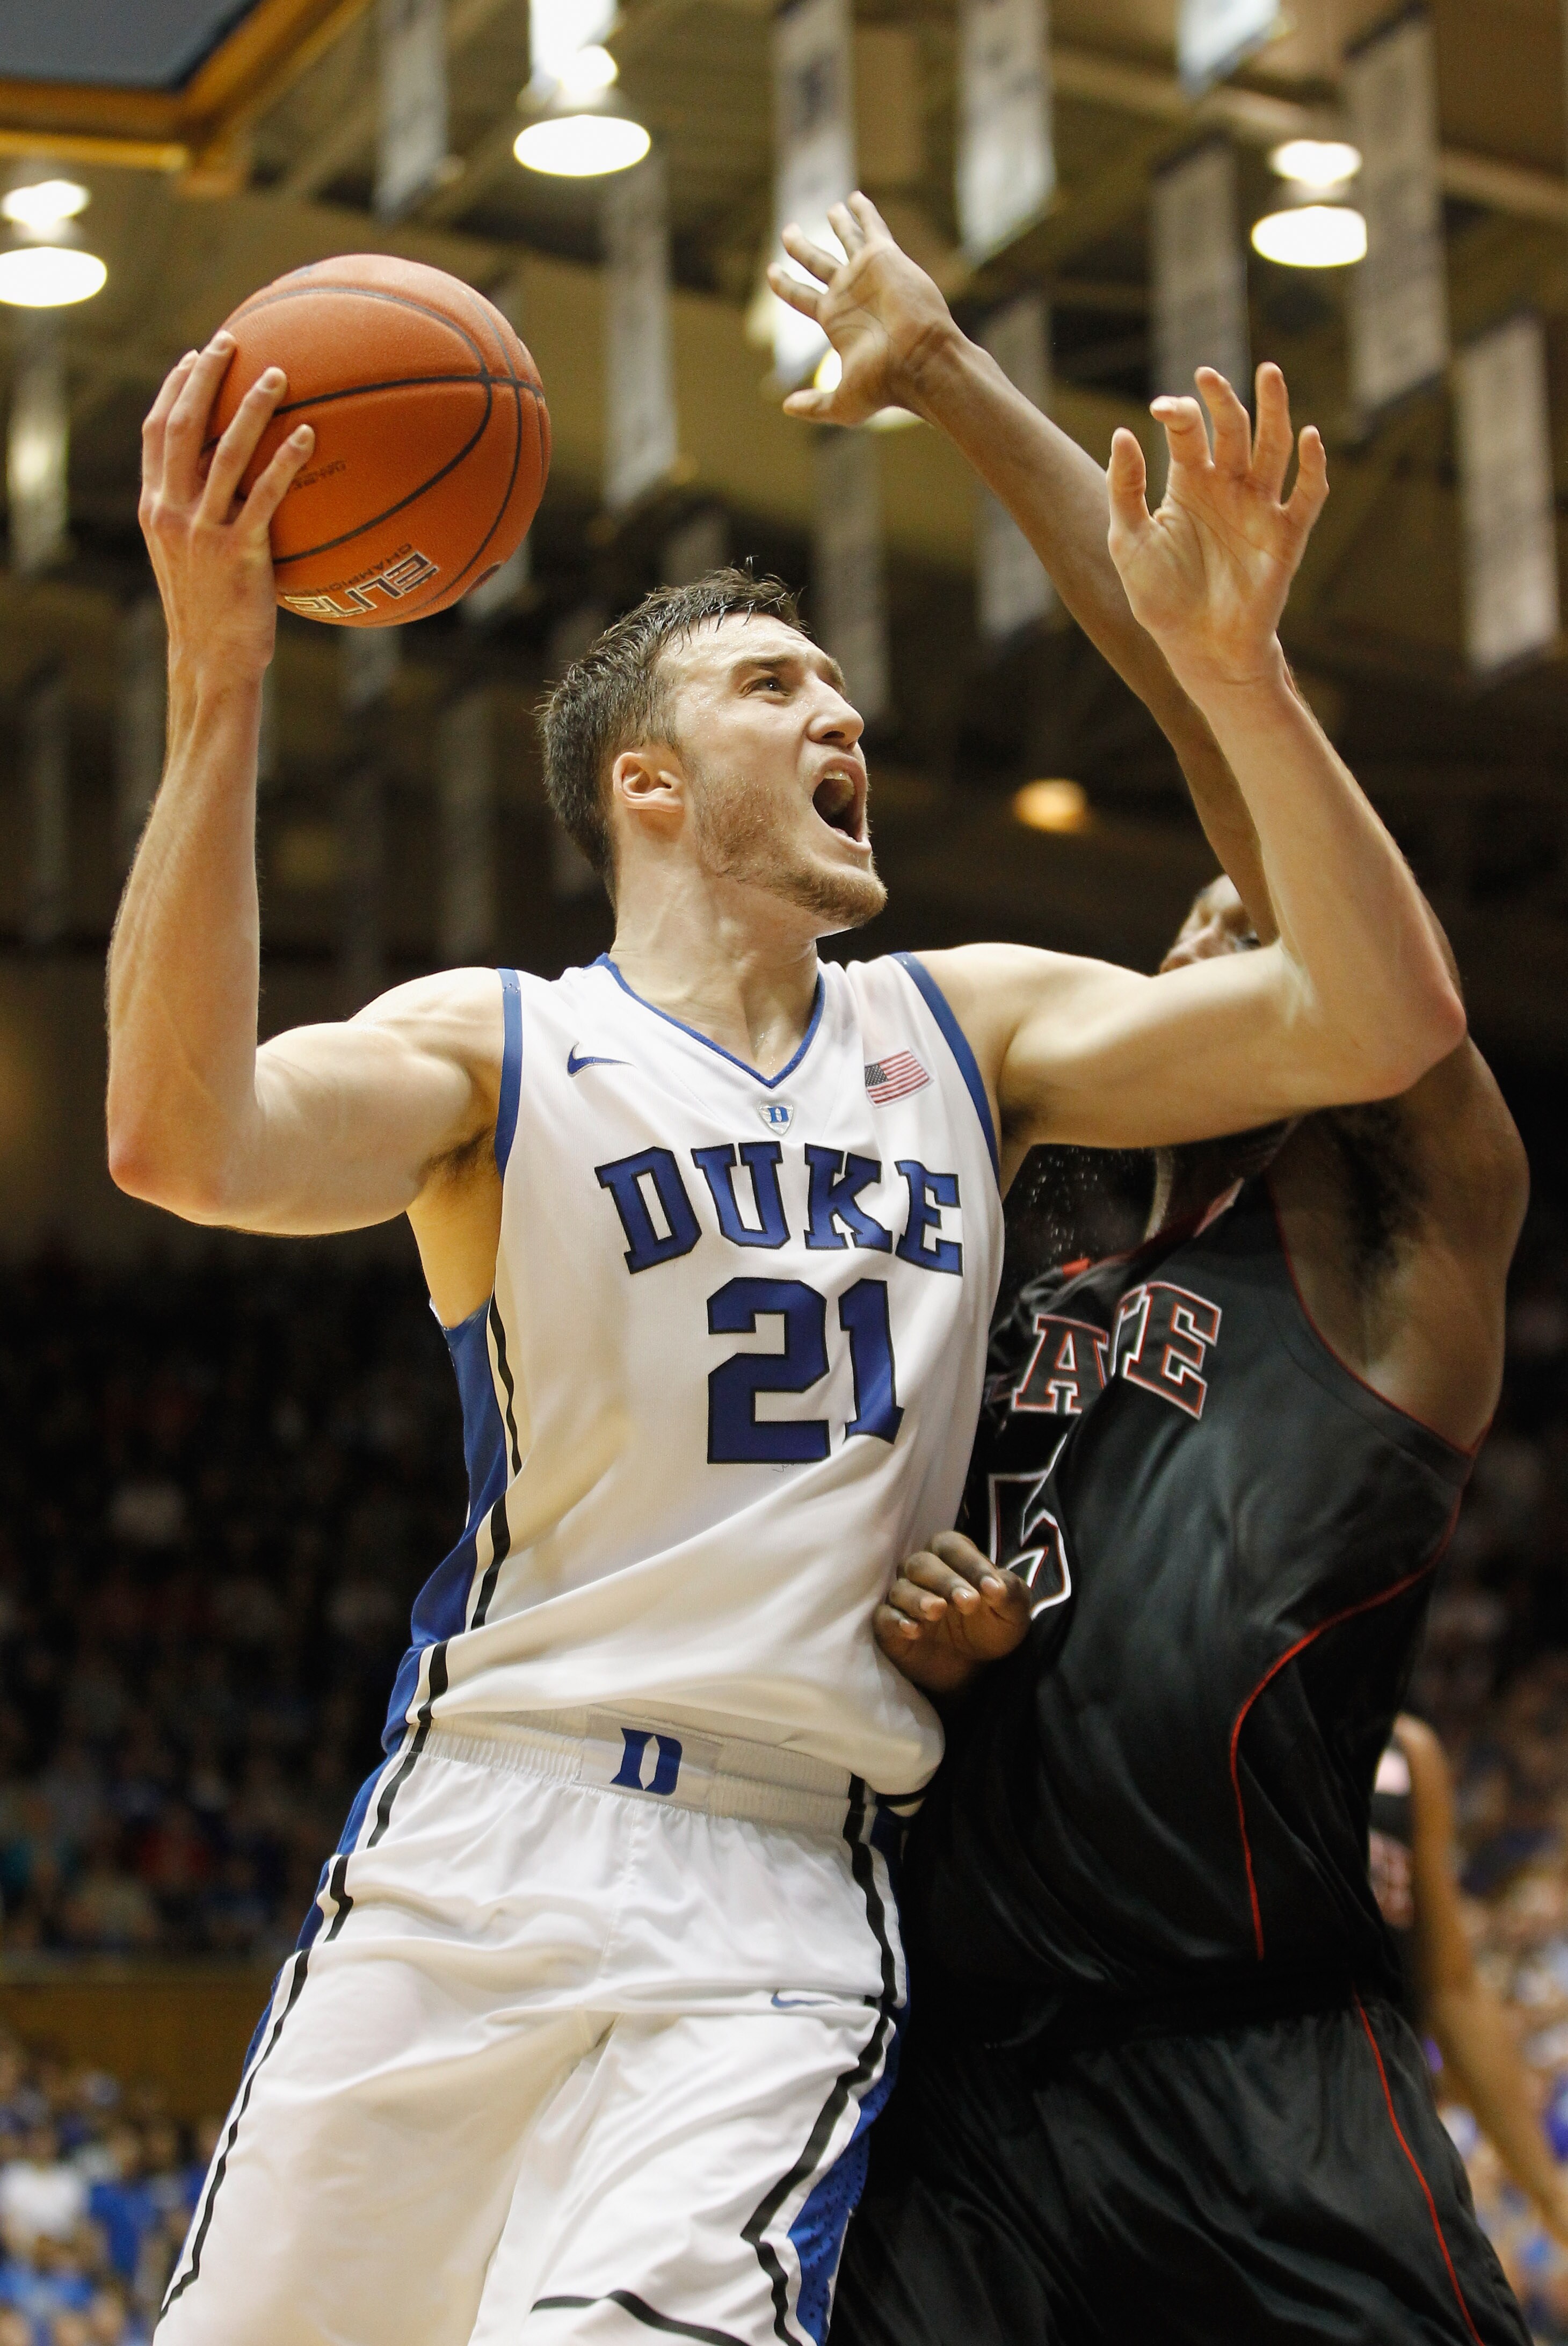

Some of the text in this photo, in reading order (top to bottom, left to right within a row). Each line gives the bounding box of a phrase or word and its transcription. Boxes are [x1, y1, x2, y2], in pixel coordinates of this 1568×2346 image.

[284, 549, 439, 618] ELITE
[767, 1106, 789, 1123] D
[594, 1141, 963, 1277] DUKE
[707, 1277, 904, 1465] 21
[609, 1727, 683, 1796] D
